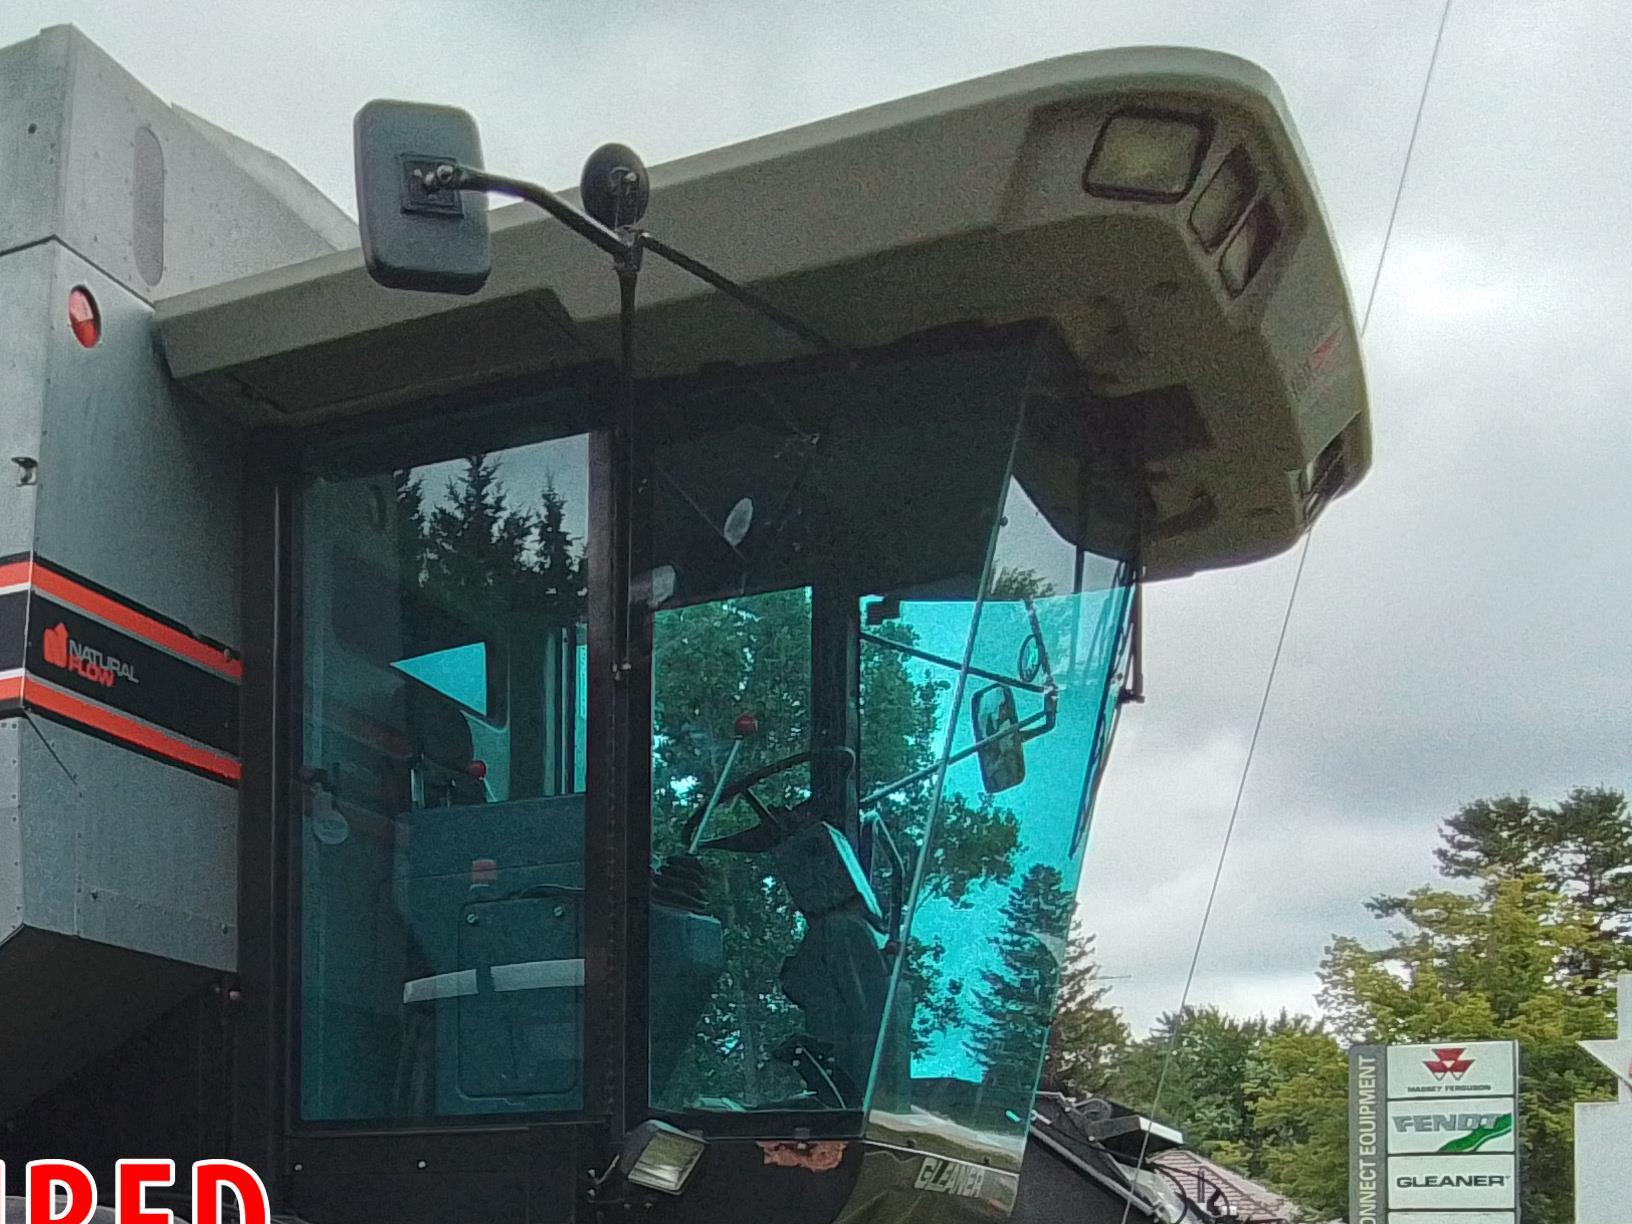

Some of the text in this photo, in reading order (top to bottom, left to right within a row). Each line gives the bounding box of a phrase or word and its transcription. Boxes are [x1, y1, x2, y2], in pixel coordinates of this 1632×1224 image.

[68, 654, 116, 688] FLOW
[69, 639, 140, 684] NATURAL
[1358, 1055, 1377, 1158] EQUIPMENT
[1392, 1113, 1502, 1132] FENDT
[914, 1157, 986, 1198] GLEANER
[1396, 1175, 1505, 1188] GLEANER
